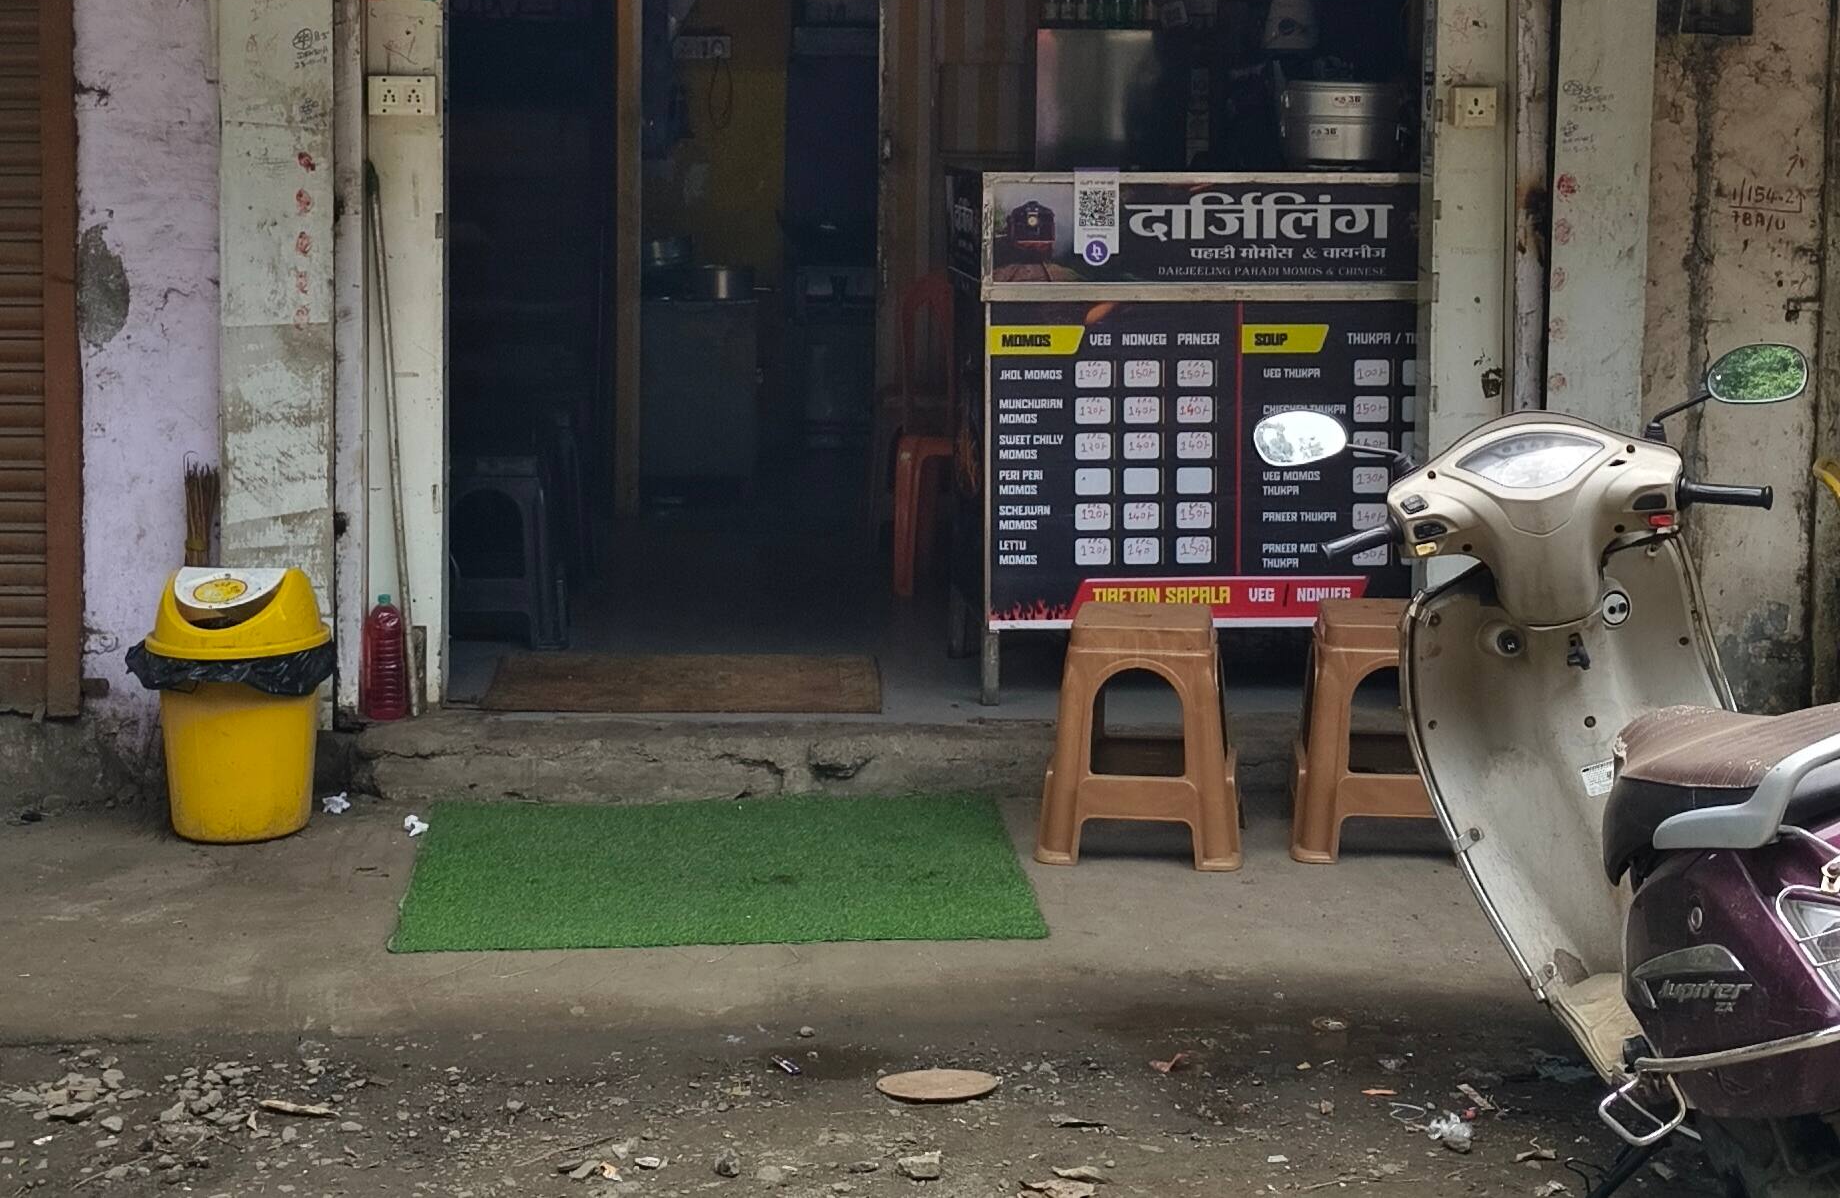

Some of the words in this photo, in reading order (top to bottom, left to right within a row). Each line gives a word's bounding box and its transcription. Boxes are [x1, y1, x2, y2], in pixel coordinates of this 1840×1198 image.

[1125, 192, 1394, 241] दार्जिलिंग
[1240, 244, 1293, 259] मोमोस
[1302, 248, 1318, 259] &
[1158, 266, 1230, 275] DARJEELING
[1234, 266, 1279, 275] PAHADI
[1282, 266, 1322, 275] MOMOS
[1338, 266, 1386, 275] CHINESE
[1002, 334, 1051, 347] MOMOS
[1089, 334, 1112, 346] VEG
[1122, 333, 1167, 345] NONVEG
[1177, 333, 1220, 345] PANEER
[1255, 333, 1288, 346] SOUP
[1347, 332, 1391, 344] THUKPA
[1000, 370, 1022, 380] JHOL
[1025, 370, 1062, 380] MOMOS
[1264, 368, 1281, 378] VEG
[1284, 368, 1320, 378] THUKPA
[1000, 399, 1063, 409] MUNCHURIAN
[1000, 414, 1037, 424] MOMOS
[1000, 435, 1030, 445] SWEET
[1033, 435, 1063, 445] CHILLY
[1000, 450, 1037, 459] MOMOS
[1000, 470, 1020, 480] PERI
[1022, 470, 1043, 480] PERI
[1263, 471, 1280, 481] VEG
[1283, 471, 1320, 481] MOMOS
[1000, 485, 1037, 495] MOMOS
[1263, 486, 1299, 496] THUKPA
[1263, 512, 1298, 522] PANEER
[1300, 512, 1336, 522] THUKPA
[1000, 520, 1037, 530] MOMOS
[1000, 541, 1026, 550] LETTU
[1263, 543, 1297, 552] PANEER
[1000, 555, 1037, 564] MOMOS
[1263, 558, 1299, 568] THUKPA
[1165, 586, 1231, 604] SAPALA
[1248, 587, 1275, 602] VEG
